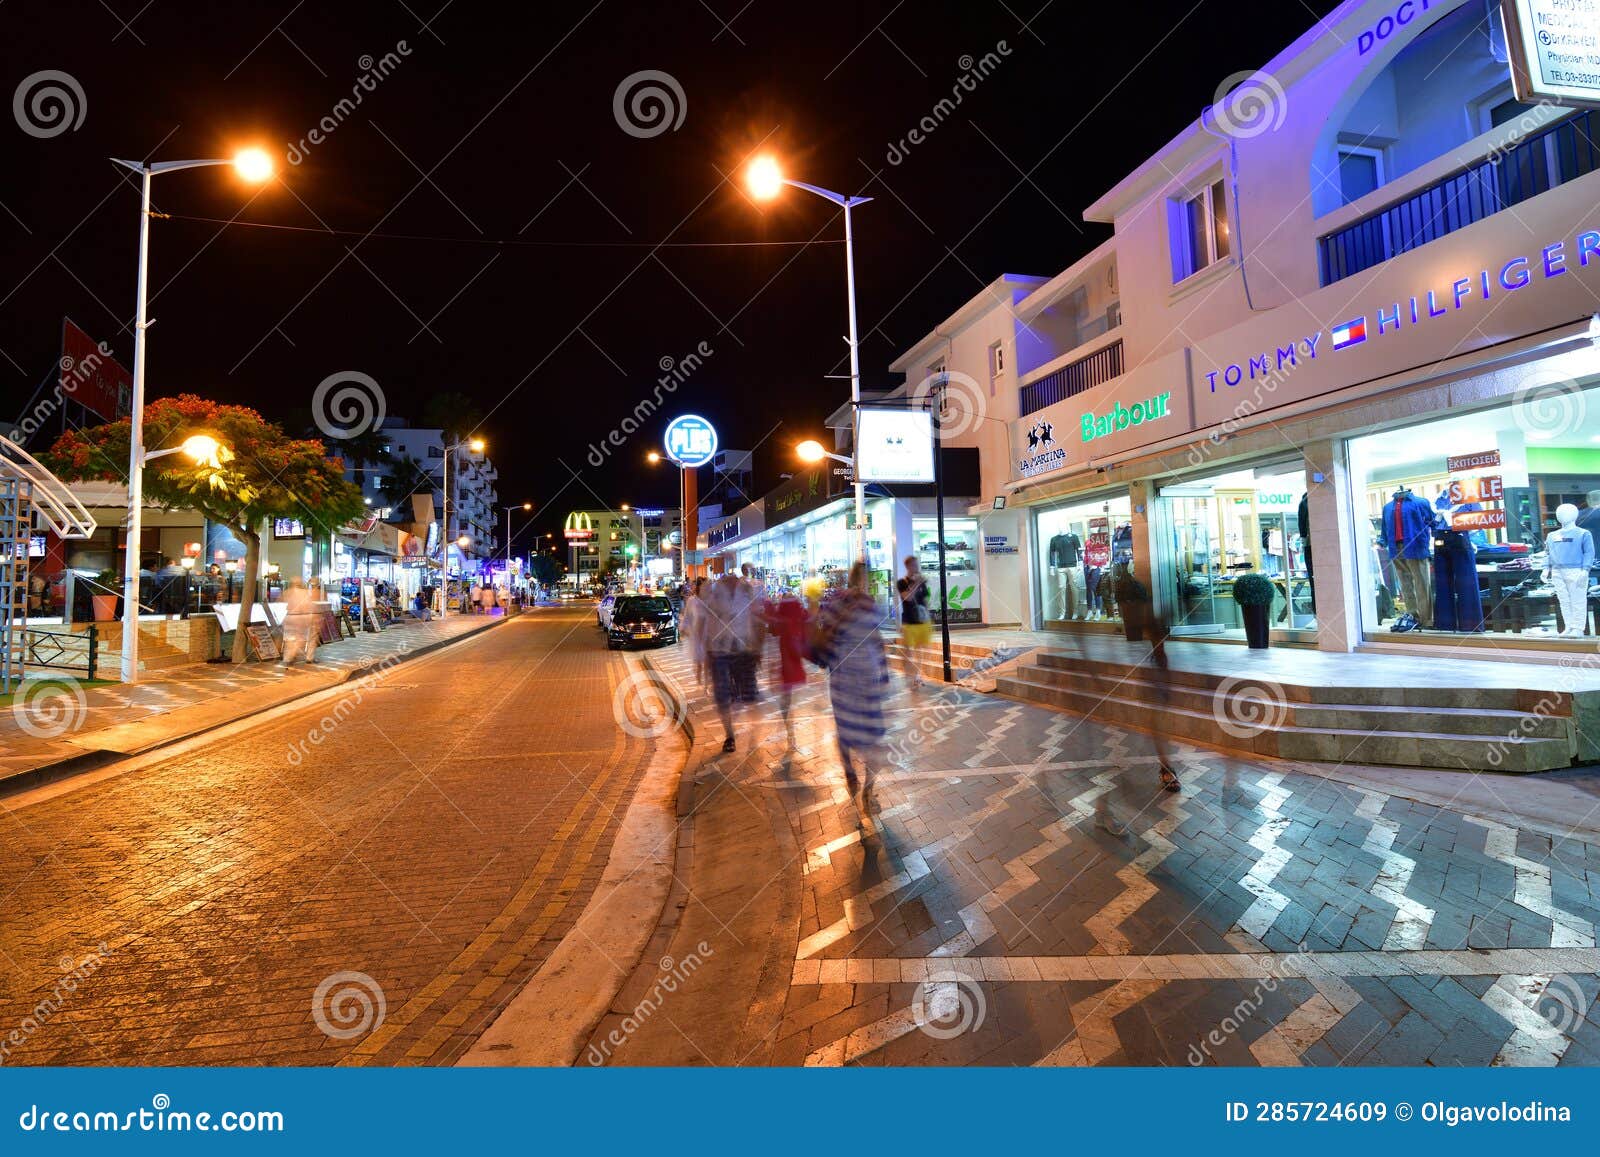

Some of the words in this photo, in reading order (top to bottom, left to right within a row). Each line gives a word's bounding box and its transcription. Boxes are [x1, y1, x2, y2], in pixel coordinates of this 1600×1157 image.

[1205, 331, 1322, 393] TOMMY
[1376, 230, 1600, 336] HILFIGER
[1080, 391, 1171, 443] Barbour
[1452, 479, 1502, 501] SALE
